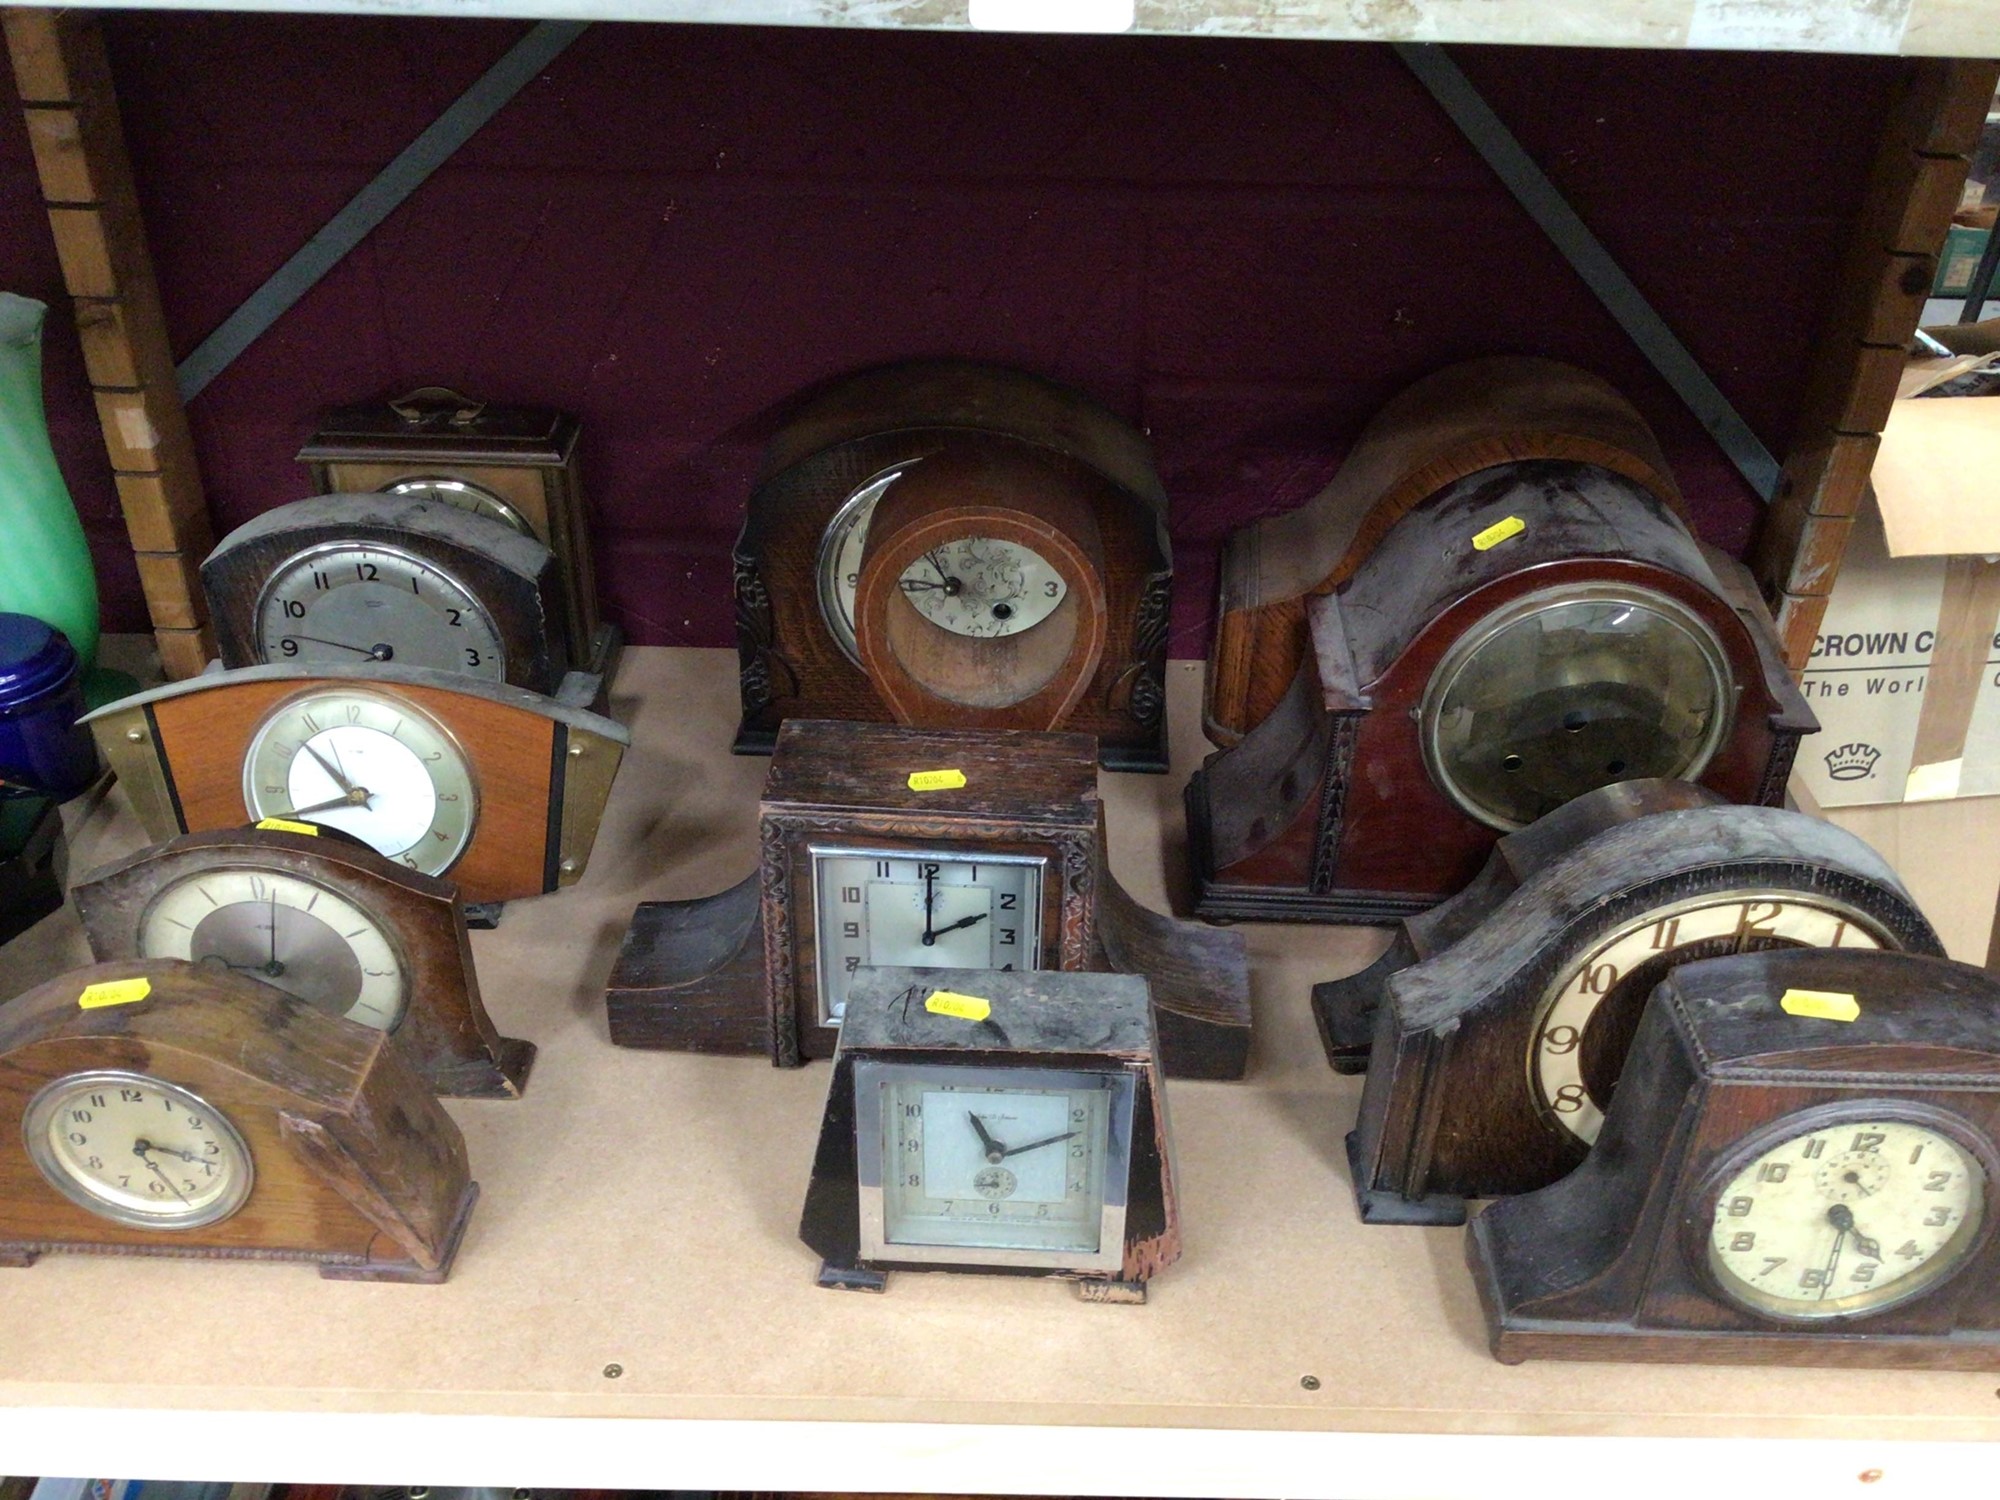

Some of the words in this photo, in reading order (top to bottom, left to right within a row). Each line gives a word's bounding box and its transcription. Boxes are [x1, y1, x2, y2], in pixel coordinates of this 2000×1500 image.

[314, 572, 329, 589] 11
[356, 564, 379, 581] 12
[412, 577, 418, 594] 1
[1044, 582, 1058, 597] 3
[283, 600, 305, 618] 10
[446, 609, 461, 627] 2
[281, 639, 298, 657] 9
[1809, 632, 1908, 657] CROWN
[465, 649, 480, 666] 3
[1804, 681, 1849, 697] The
[347, 705, 362, 724] 12
[423, 752, 442, 764] 2
[432, 830, 450, 842] 4
[403, 854, 418, 870] 5
[877, 861, 890, 878] 11
[918, 863, 940, 880] 12
[972, 865, 977, 882] 1
[842, 886, 860, 903] 10
[1000, 893, 1016, 910] 2
[1732, 902, 1783, 938] 12
[844, 922, 859, 938] 9
[1000, 928, 1016, 946] 3
[1650, 919, 1682, 950] 11
[1831, 922, 1847, 948] 1
[1578, 963, 1618, 994] 10
[1543, 1025, 1581, 1055] 9
[91, 1095, 105, 1107] 11
[120, 1090, 143, 1102] 12
[1552, 1084, 1588, 1113] 8
[165, 1100, 172, 1112] 1
[905, 1103, 921, 1118] 10
[72, 1110, 92, 1123] 10
[188, 1117, 203, 1130] 2
[1072, 1109, 1085, 1123] 2
[69, 1132, 87, 1146] 9
[907, 1139, 919, 1152] 9
[1850, 1132, 1886, 1152] 12
[204, 1141, 220, 1155] 3
[1802, 1138, 1826, 1159] 11
[1909, 1145, 1923, 1165] 1
[89, 1156, 103, 1170] 8
[118, 1175, 131, 1187] 7
[908, 1175, 920, 1187] 8
[1756, 1162, 1790, 1183] 10
[148, 1180, 165, 1194] 6
[1923, 1171, 1952, 1192] 2
[988, 1201, 1000, 1214] 6
[1036, 1204, 1048, 1217] 5
[1727, 1196, 1754, 1217] 9
[1923, 1206, 1951, 1227] 3
[1730, 1231, 1756, 1252] 8
[1895, 1239, 1923, 1260] 4
[1760, 1257, 1787, 1276] 7
[1851, 1263, 1879, 1282] 5
[1798, 1268, 1824, 1289] 6
